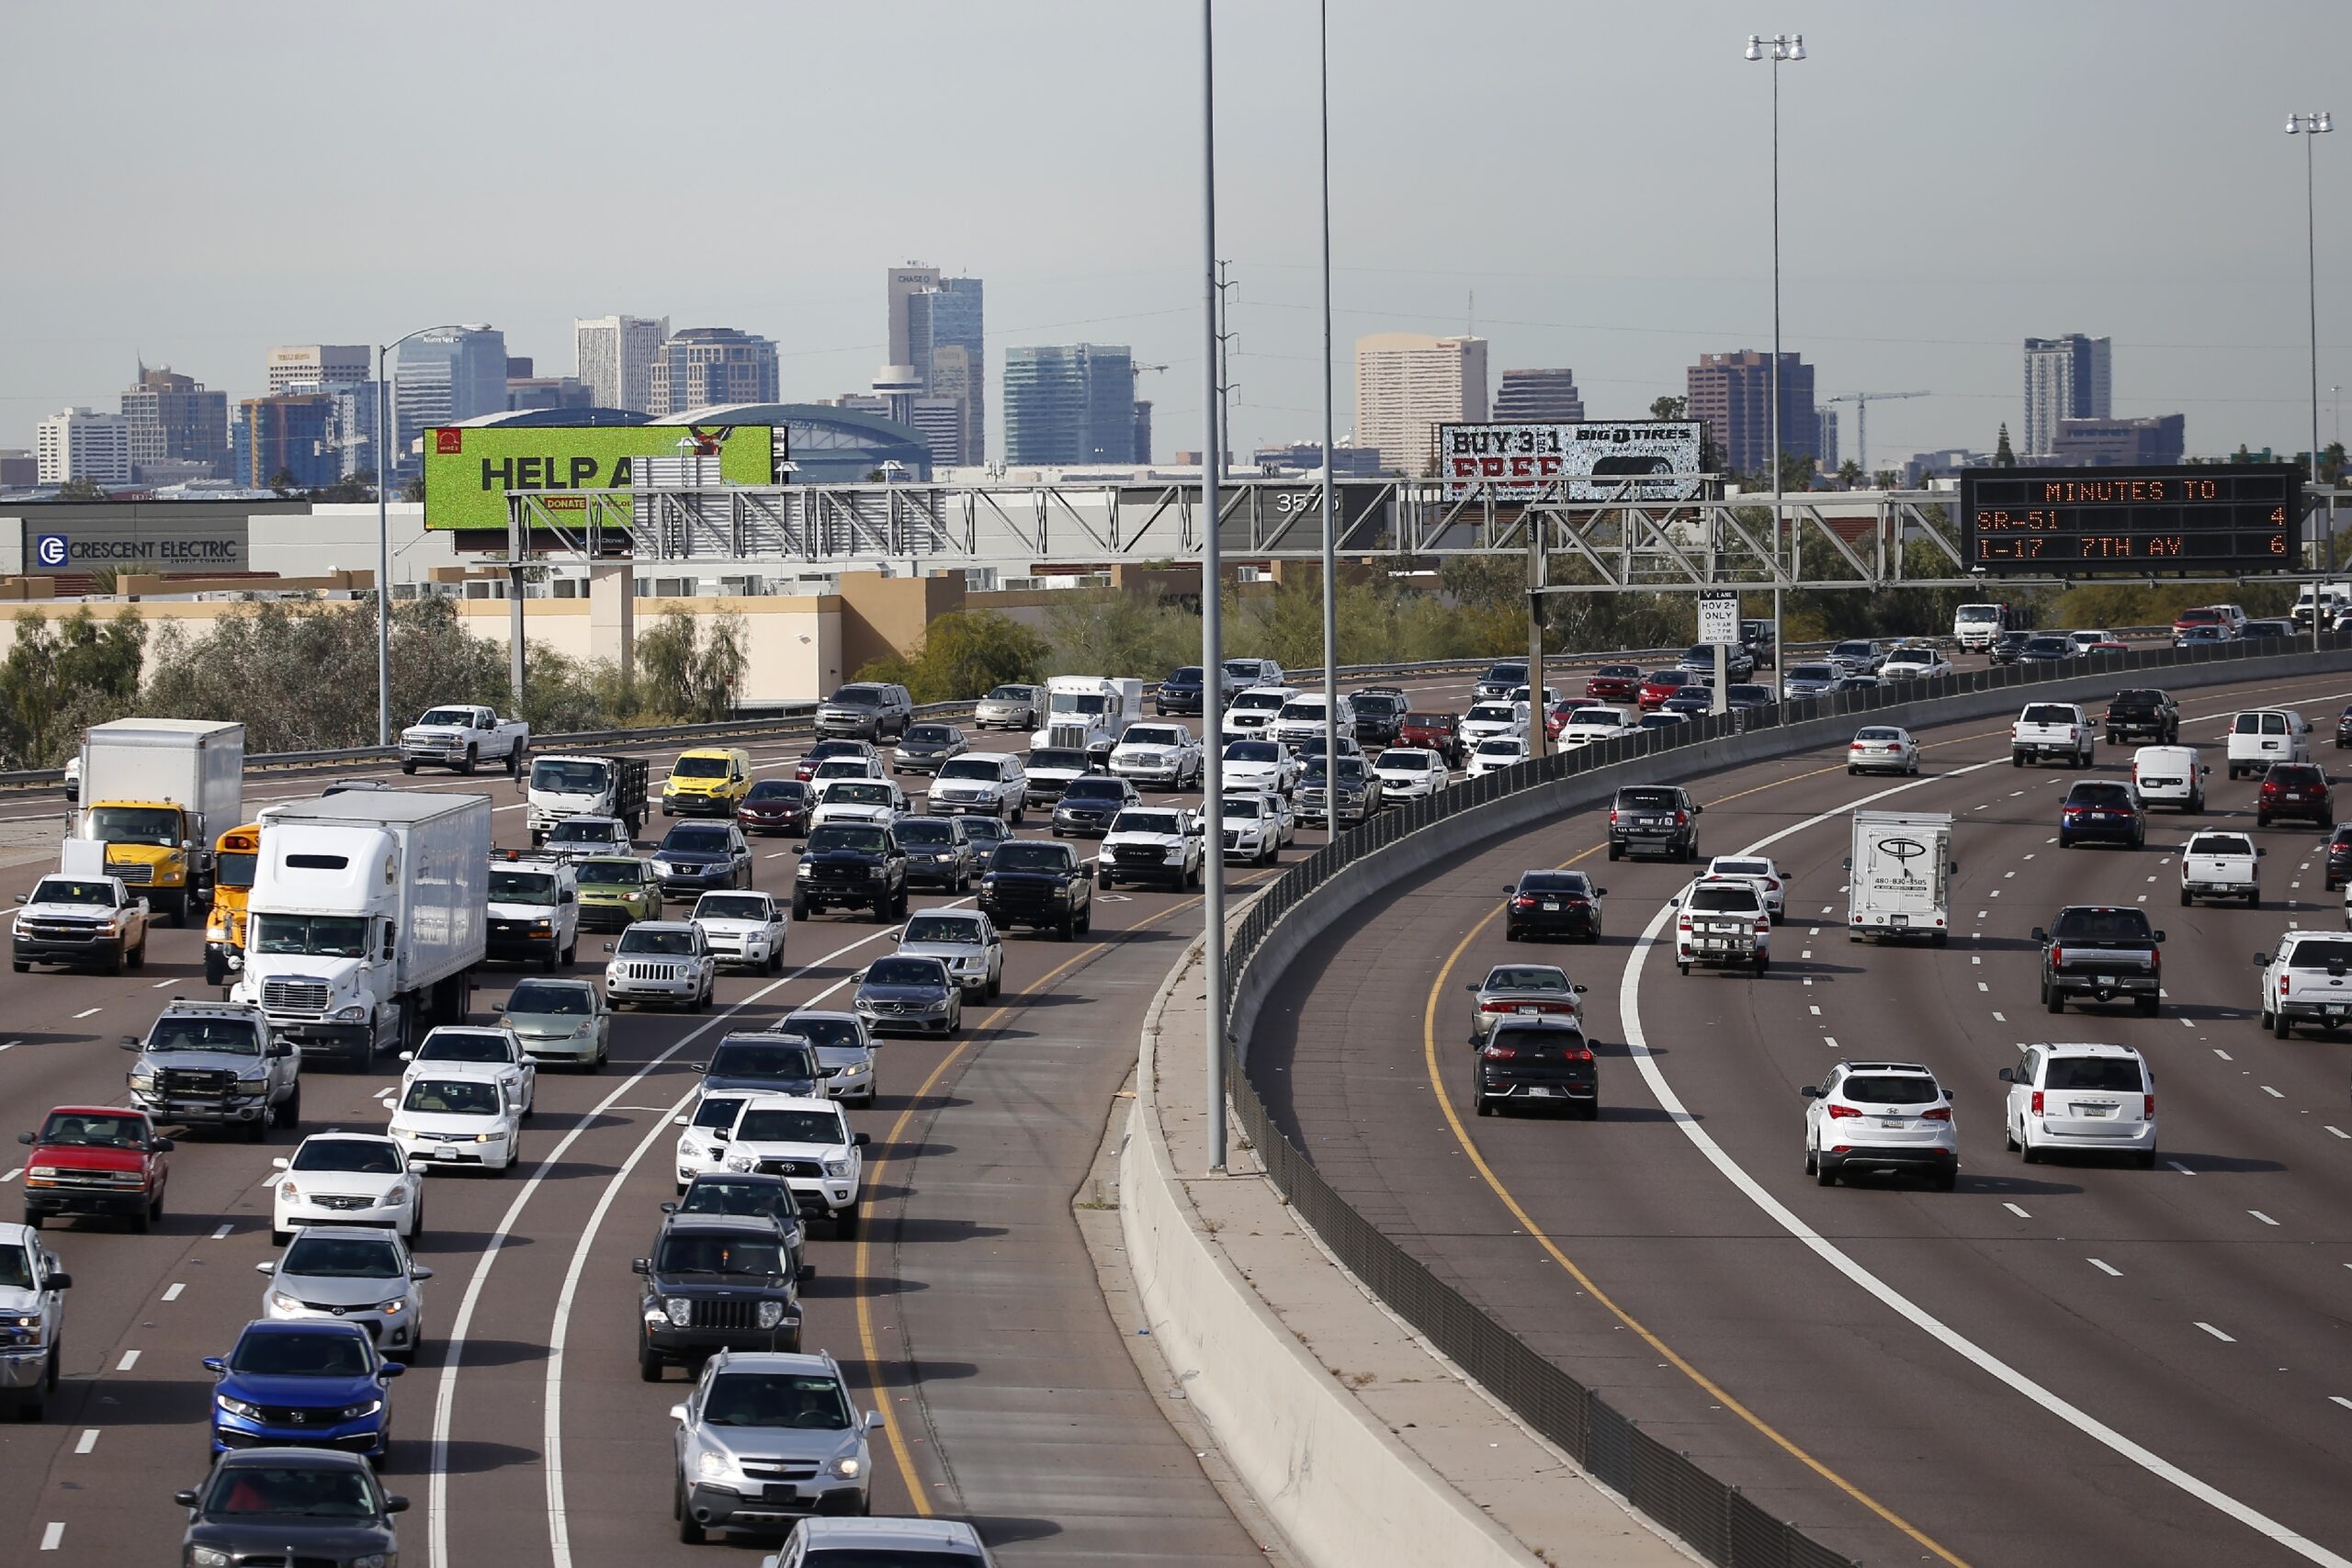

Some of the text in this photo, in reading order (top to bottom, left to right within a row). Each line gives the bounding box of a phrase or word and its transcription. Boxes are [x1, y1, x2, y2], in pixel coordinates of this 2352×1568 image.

[1452, 431, 1512, 454] BUY
[1519, 431, 1533, 453] 3
[1548, 431, 1562, 453] 1
[1576, 430, 1610, 440] BIG
[1633, 429, 1690, 440] TIRES
[481, 457, 598, 491] HELP
[1452, 457, 1563, 488] FREE
[2046, 480, 2214, 502] MINUTES TO
[547, 500, 585, 508] DONATE
[1978, 507, 2285, 530] SR-51 4
[70, 540, 236, 558] CRESCENT ELECTRIC
[1981, 535, 2285, 558] I-17 7TH AV 6
[1702, 602, 1722, 610] HOV
